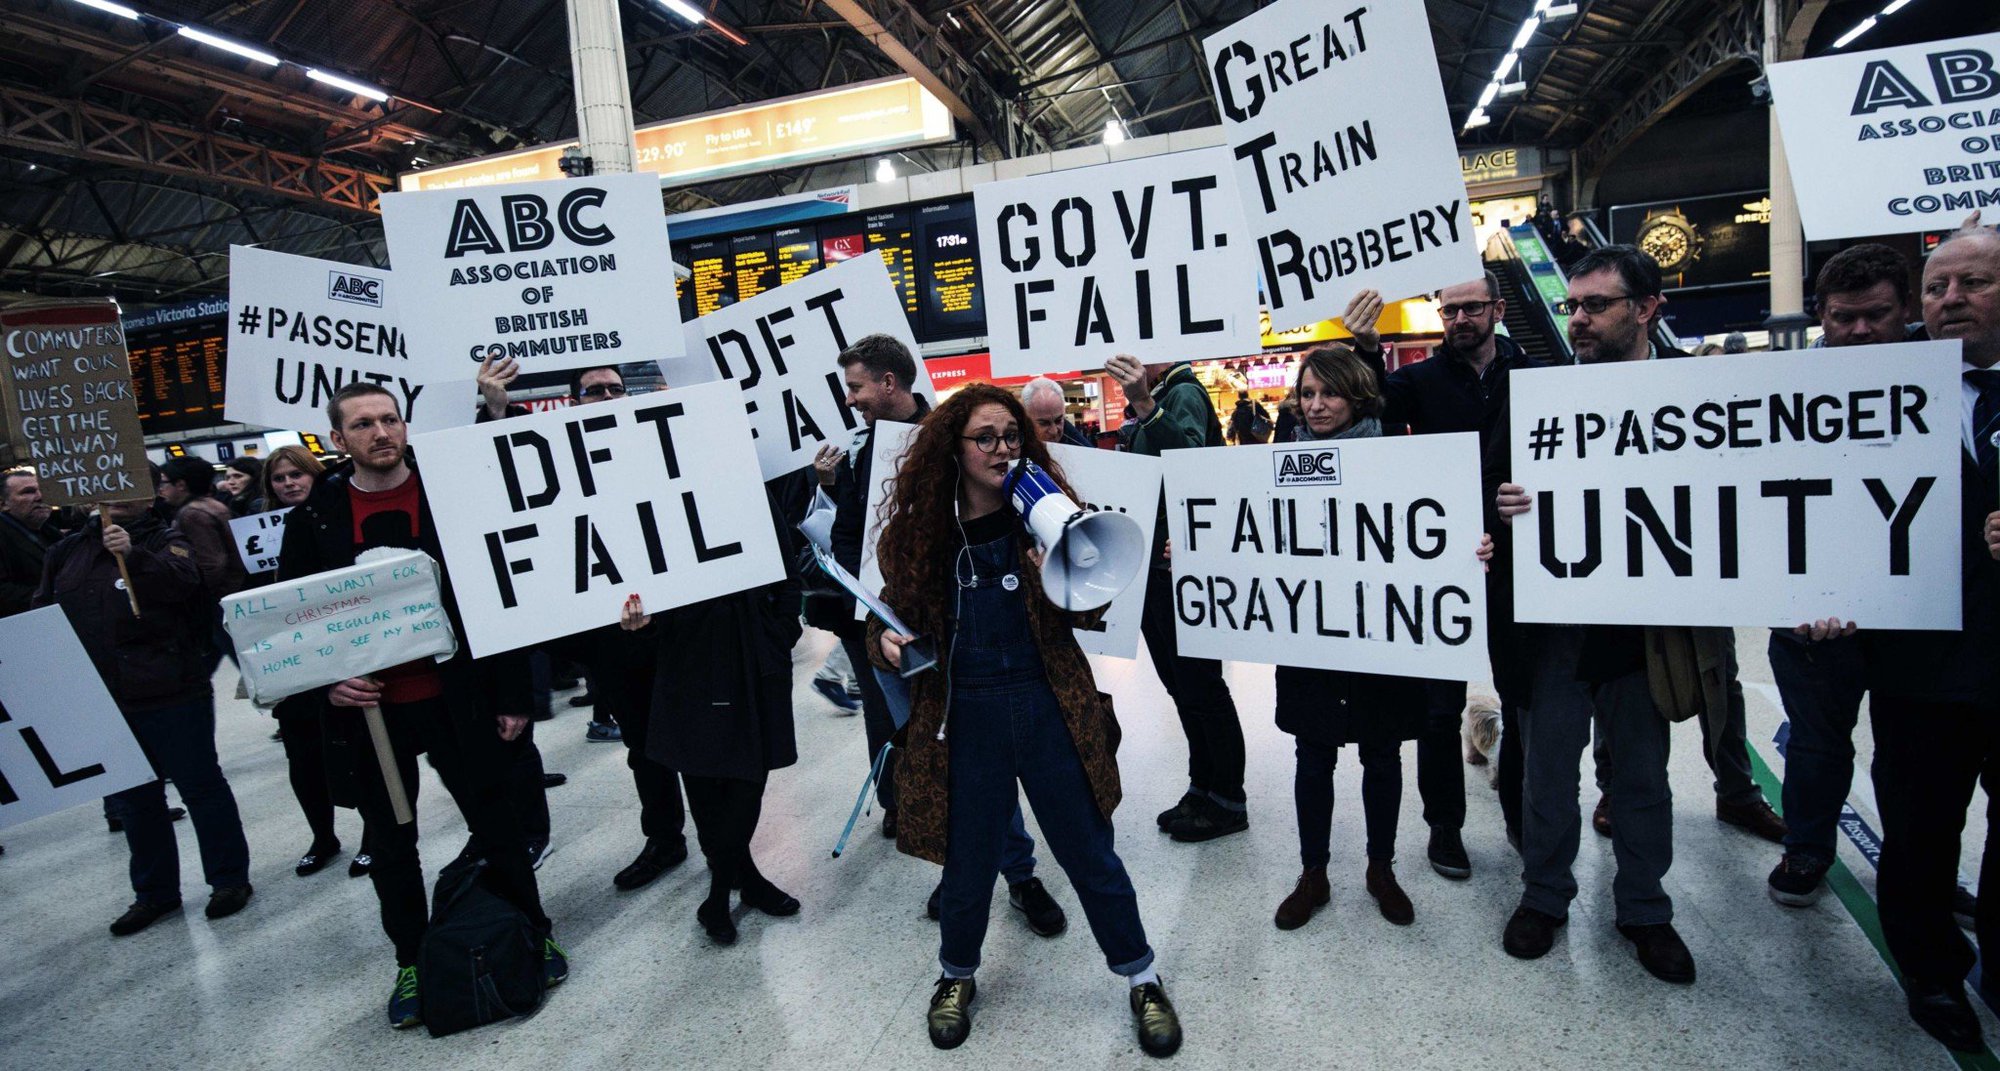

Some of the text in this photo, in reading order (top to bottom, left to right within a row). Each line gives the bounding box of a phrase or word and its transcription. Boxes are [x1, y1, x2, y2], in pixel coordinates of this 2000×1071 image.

[1213, 6, 1368, 123] GREAT
[1234, 120, 1378, 214] TRAIN
[444, 187, 616, 259] ABC
[997, 175, 1228, 273] GOVT.
[450, 254, 616, 286] ASSOCIATION
[1257, 199, 1461, 310] ROBBERY
[333, 276, 379, 299] ABC
[521, 286, 554, 305] OF
[156, 305, 196, 323] Victoria
[495, 308, 588, 334] BRITISH
[1014, 264, 1225, 350] FAIL
[6, 324, 123, 358] COMMUTERS
[470, 331, 622, 363] COMMUTERS
[706, 288, 850, 391] DFT
[13, 353, 119, 381] WANT OUR
[932, 369, 966, 379] EXPRESS
[18, 380, 133, 411] LIVES BACK
[23, 409, 113, 439] GET THE
[1528, 384, 1930, 461] #PASSENGER
[31, 432, 118, 459] RAILWAY
[493, 402, 685, 513] DFT
[38, 452, 124, 479] BACK ON
[1279, 452, 1336, 476] ABC
[1286, 475, 1337, 483] @ABCOMMUTERS
[58, 471, 135, 498] TRACK
[1185, 497, 1447, 564] FAILING
[1537, 476, 1937, 580] UNITY
[483, 490, 744, 610] FAIL
[233, 563, 420, 620] ALL I WANT FOR
[253, 601, 437, 652] IS A REGULAR TRAIN
[285, 594, 372, 626] CHRISTMAS
[1176, 574, 1473, 647] GRAYLING
[263, 618, 441, 675] HOME TO SEE MY KIDS
